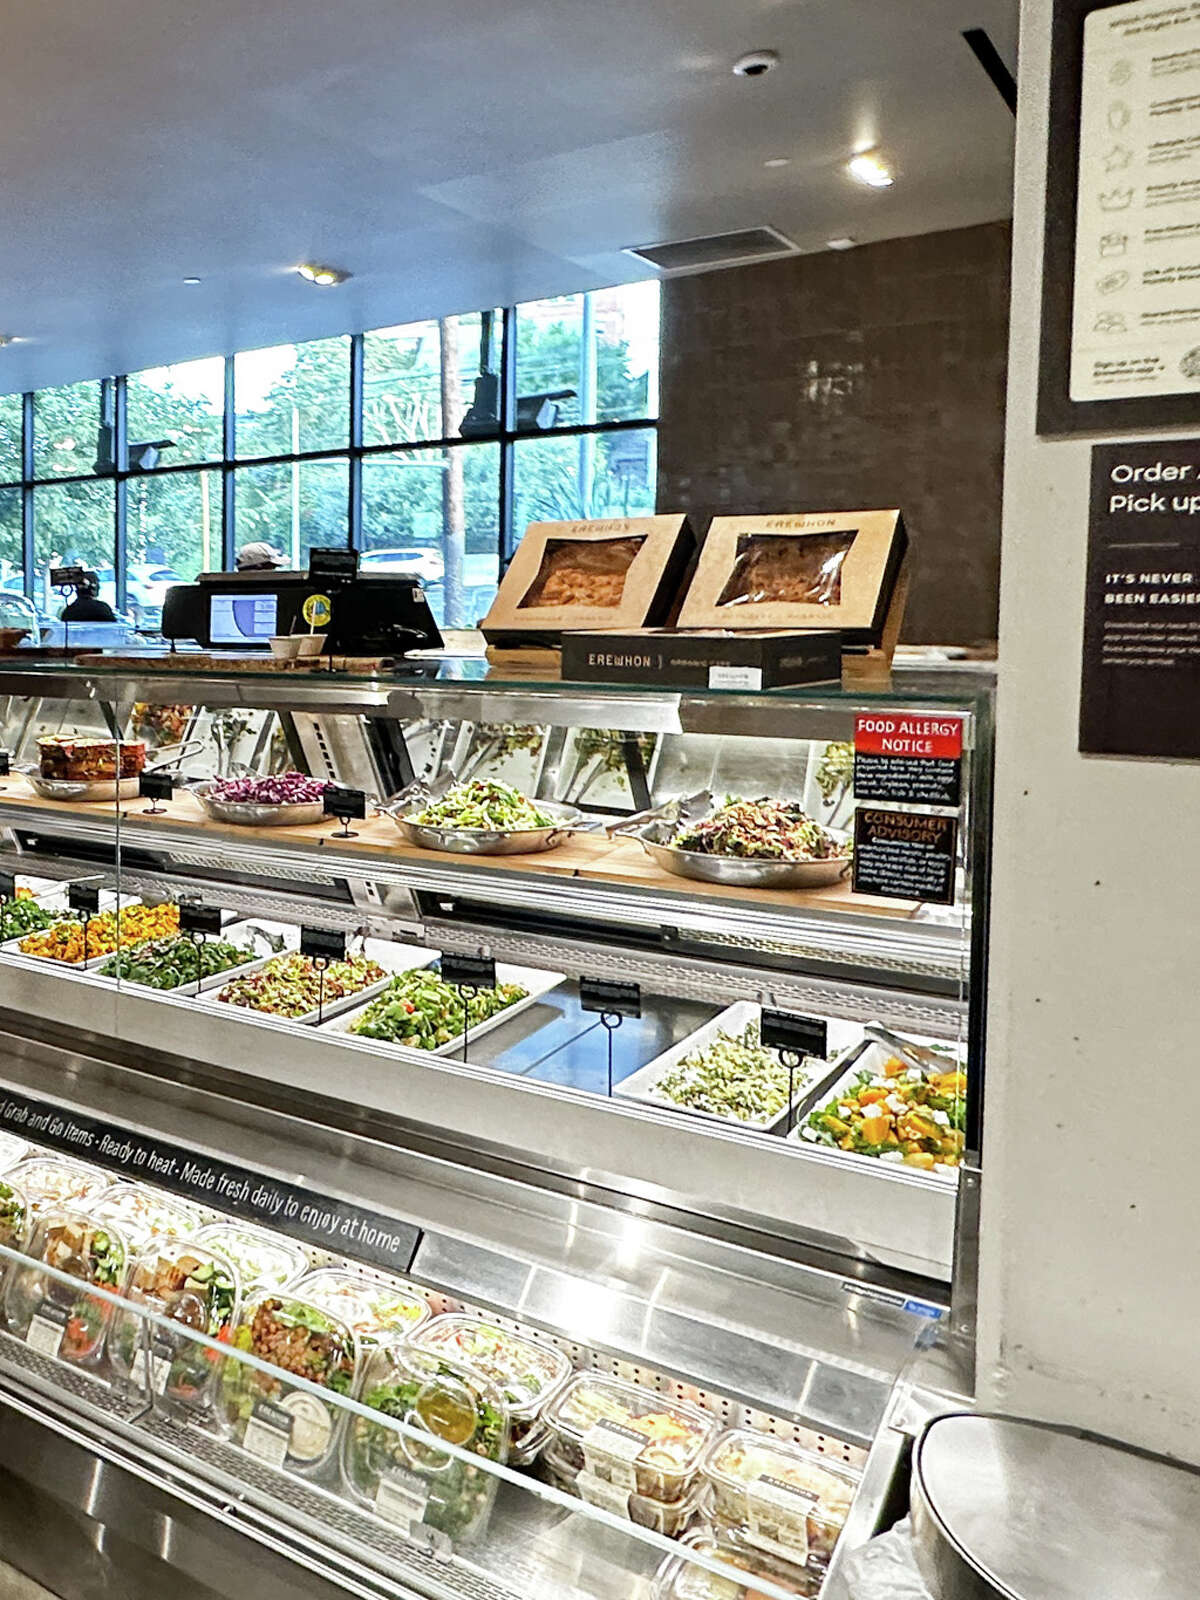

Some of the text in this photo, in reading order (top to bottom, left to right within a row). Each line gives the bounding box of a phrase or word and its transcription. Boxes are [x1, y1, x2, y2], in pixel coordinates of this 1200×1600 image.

[1111, 462, 1192, 483] Order
[1110, 492, 1200, 514] Pick up
[1105, 572, 1193, 584] IT'S NEVER
[1104, 593, 1145, 604] BEEN
[588, 654, 651, 667] EREWHON
[858, 719, 958, 736] FOOD ALLERGY
[882, 738, 934, 753] NOTICE
[864, 812, 947, 831] CONSUMER
[867, 825, 943, 843] ADVISORY
[4, 1101, 28, 1126] Grab
[30, 1111, 49, 1131] and
[49, 1116, 64, 1136] Go
[65, 1121, 94, 1147] Items
[99, 1135, 133, 1166] Ready
[132, 1145, 147, 1165] to
[148, 1150, 176, 1175] heat
[181, 1161, 216, 1190] Made
[216, 1174, 250, 1202] fresh
[251, 1184, 283, 1216] daily
[283, 1198, 299, 1217] to
[300, 1203, 338, 1235] enjoy
[340, 1216, 358, 1239] at
[358, 1223, 401, 1252] home
